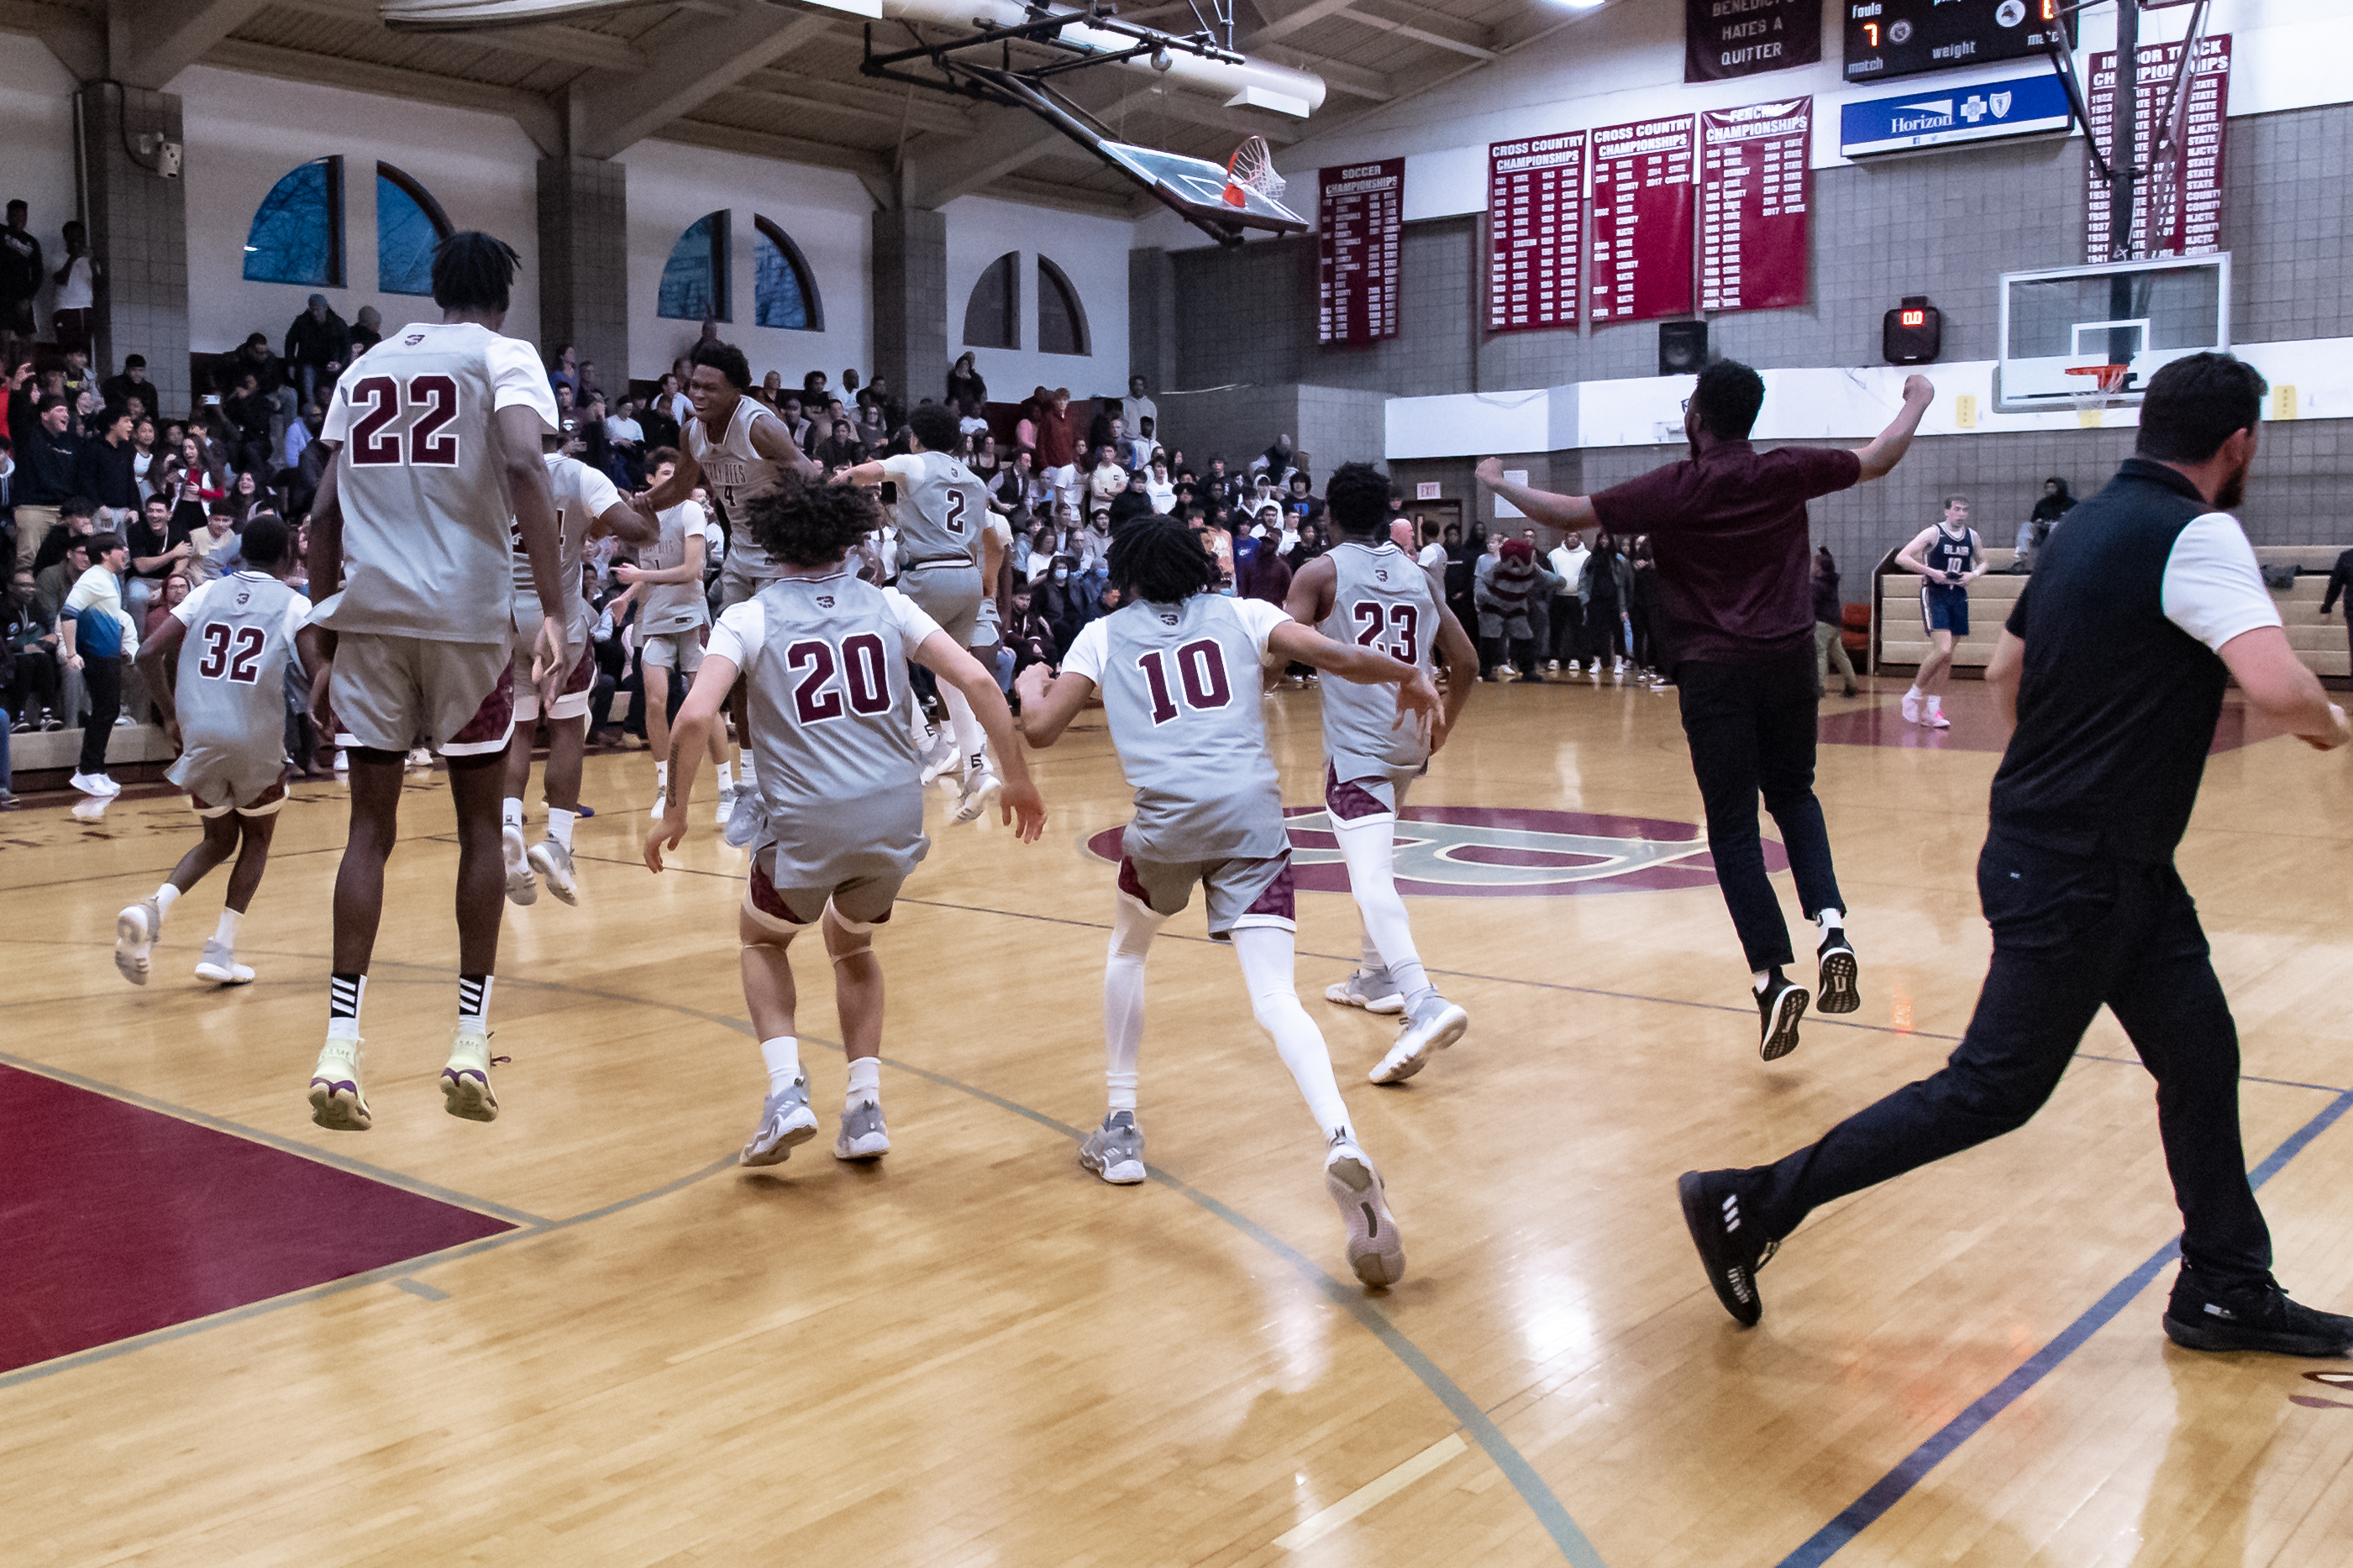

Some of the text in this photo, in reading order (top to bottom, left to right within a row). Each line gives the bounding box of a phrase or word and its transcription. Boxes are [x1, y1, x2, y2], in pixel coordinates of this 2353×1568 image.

[1852, 3, 1882, 18] fouls
[1722, 16, 1783, 40] HATES A
[1863, 23, 1879, 47] 7
[1722, 43, 1782, 66] QUITTER
[1932, 41, 1976, 60] weight
[1848, 57, 1883, 74] match
[1594, 118, 1693, 143] CROSS COUNTRY
[1706, 116, 1807, 141] CHAMPIONSHIPS
[1892, 114, 1952, 133] Horizon
[1492, 134, 1584, 157] CROSS COUNTRY
[1599, 134, 1687, 157] CHAMPIONSHIPS
[1496, 150, 1579, 170] CHAMPIONSHIPS
[1342, 165, 1381, 179] SOCCER
[1326, 176, 1398, 195] CHAMPIONSHIPS
[348, 372, 460, 468] 22
[723, 485, 738, 508] 4
[1421, 485, 1438, 498] EXIT
[945, 488, 966, 537] 2
[1943, 544, 1969, 556] BLAIR
[1947, 557, 1962, 573] 10
[1352, 600, 1420, 667] 23
[199, 621, 267, 685] 32
[784, 631, 893, 727] 20
[1135, 636, 1233, 728] 10
